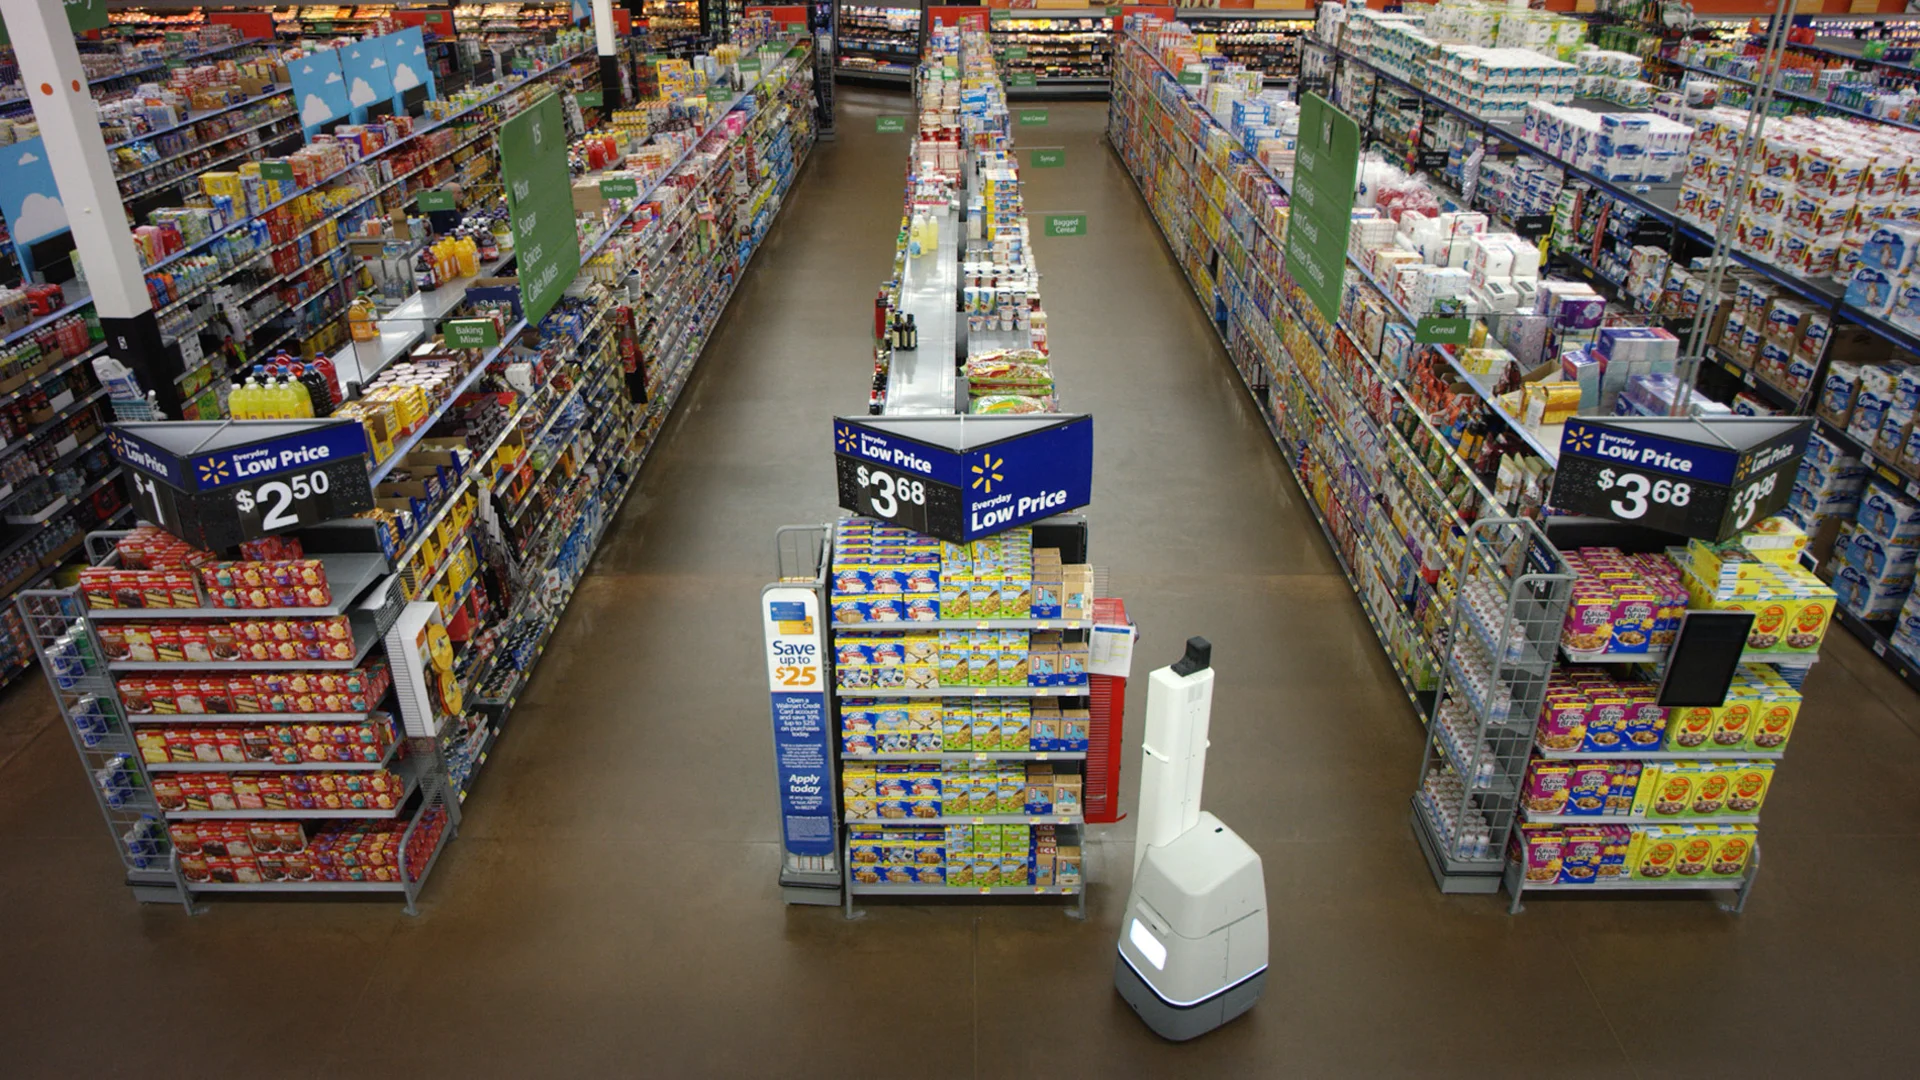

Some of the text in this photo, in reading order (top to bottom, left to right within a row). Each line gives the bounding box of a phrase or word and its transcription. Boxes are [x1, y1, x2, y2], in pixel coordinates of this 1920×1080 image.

[512, 179, 530, 204] Flour
[614, 184, 634, 192] Fillings
[518, 212, 538, 238] Sugar
[1053, 218, 1078, 226] Bagged
[523, 243, 543, 272] Spices
[528, 262, 558, 304] Cake Mixes
[456, 326, 484, 336] Baking
[1429, 325, 1456, 334] Cereal
[460, 336, 484, 344] Mixes
[860, 432, 888, 446] Everyday
[1600, 432, 1636, 446] Everyday
[124, 444, 168, 477] Low Price
[232, 448, 269, 462] Everyday
[234, 445, 330, 478] Low Price
[860, 440, 932, 474] Low Price
[1596, 440, 1692, 472] Low Price
[1751, 444, 1794, 476] Low Price
[972, 494, 1012, 512] Everyday
[972, 490, 1067, 532] Low Price
[1583, 610, 1610, 619] Raisin
[1625, 606, 1651, 615] Raisin
[773, 640, 815, 655] Save
[780, 655, 810, 666] up to
[776, 666, 816, 686] $25
[1600, 709, 1624, 717] Raisin
[1638, 708, 1663, 716] Raisin
[789, 774, 820, 785] Apply
[790, 785, 820, 795] today
